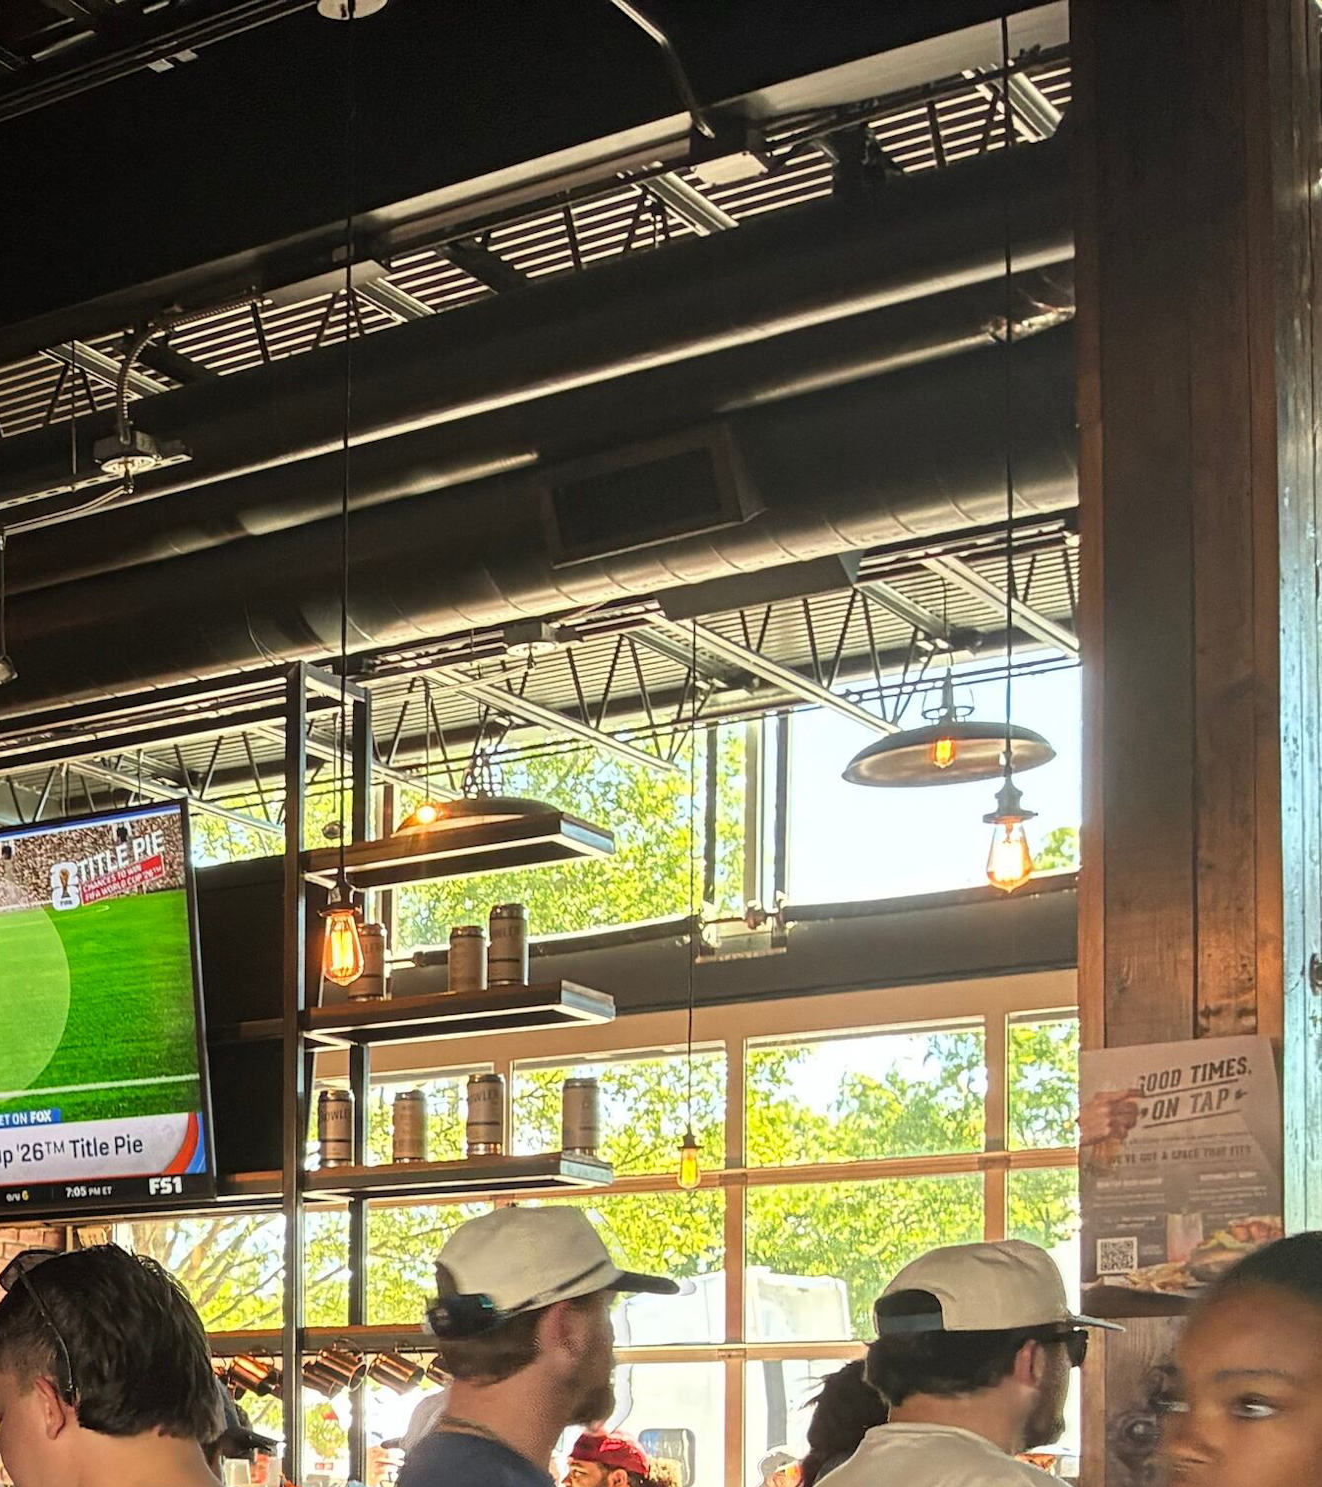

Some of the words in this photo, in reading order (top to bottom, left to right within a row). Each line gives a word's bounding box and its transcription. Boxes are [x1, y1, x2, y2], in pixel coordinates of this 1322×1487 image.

[77, 843, 130, 883] TITLE
[132, 829, 166, 861] PIE
[1152, 1096, 1180, 1121] ON
[1191, 1087, 1230, 1115] TAP
[12, 1111, 29, 1125] ON
[30, 1109, 52, 1123] FOX
[70, 1136, 110, 1159] Title
[114, 1134, 143, 1155] Pie
[65, 1184, 87, 1198] 7:05
[88, 1187, 102, 1197] PM
[102, 1186, 113, 1195] ET
[148, 1176, 183, 1196] FS1
